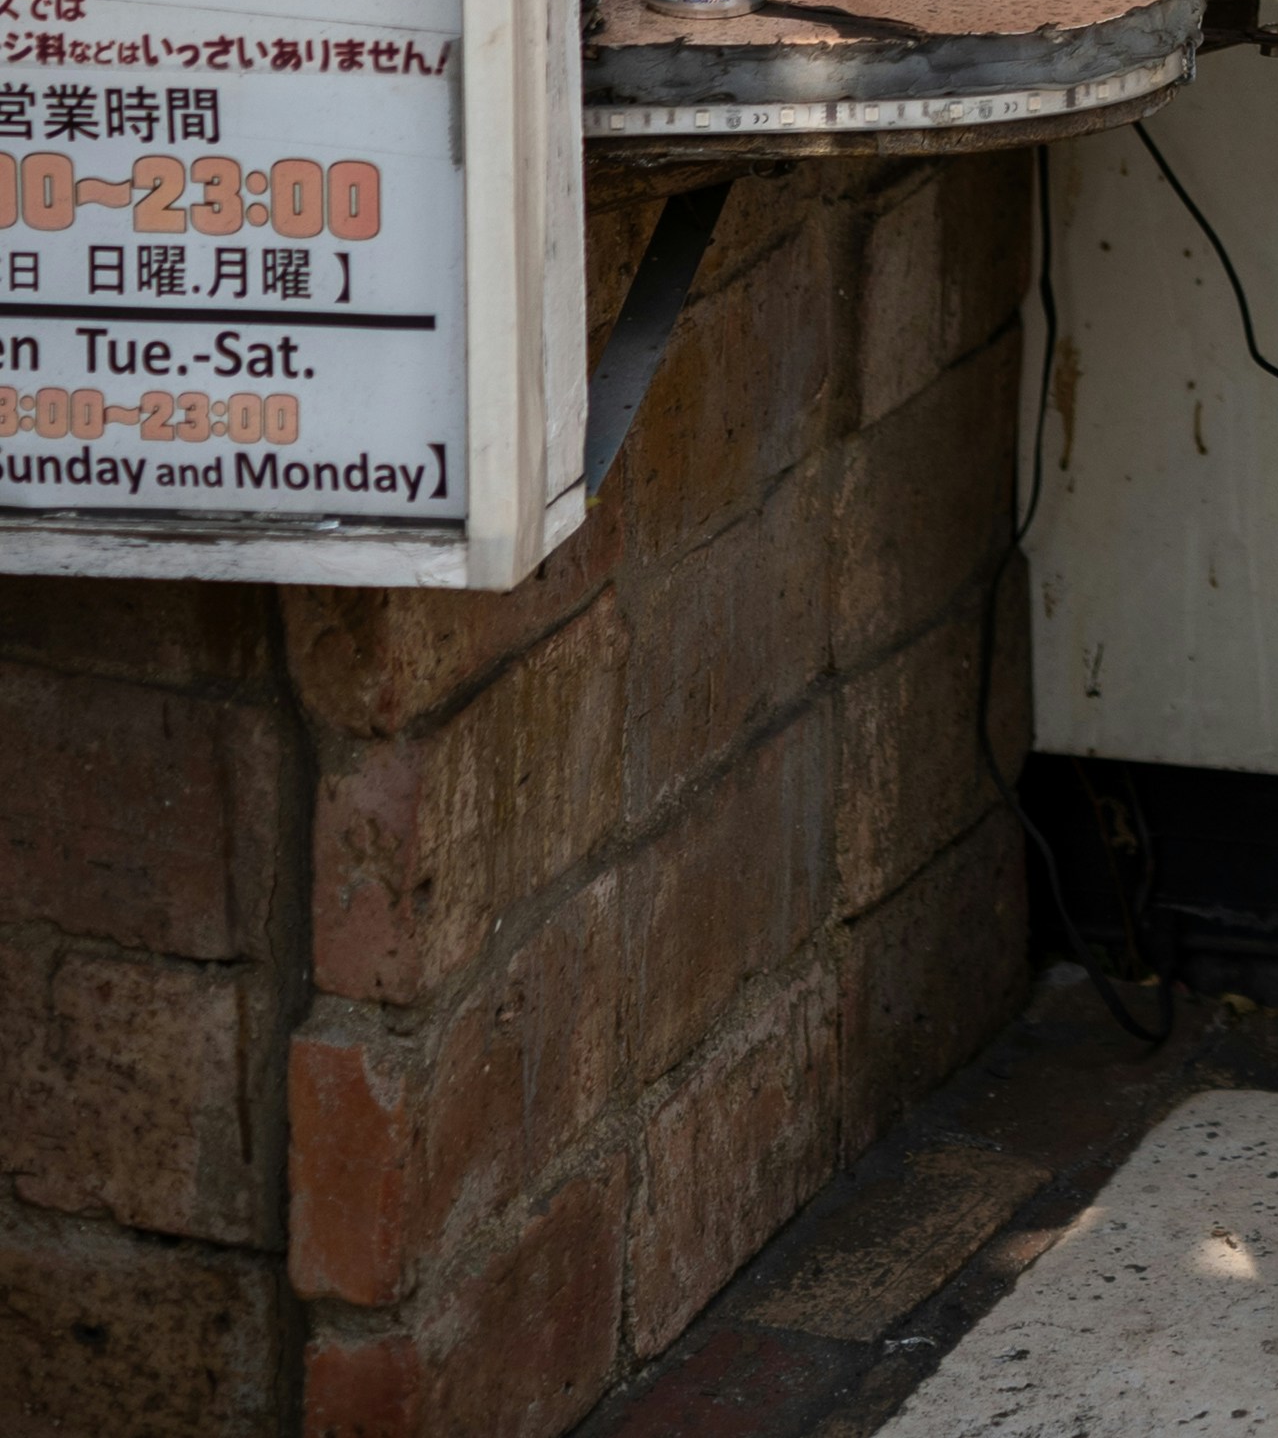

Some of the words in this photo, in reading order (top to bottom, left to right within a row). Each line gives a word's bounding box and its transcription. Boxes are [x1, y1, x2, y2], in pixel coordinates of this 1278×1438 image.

[0, 82, 220, 144] 営業時間
[76, 326, 316, 379] Tue.-Sat.
[156, 455, 223, 489] and
